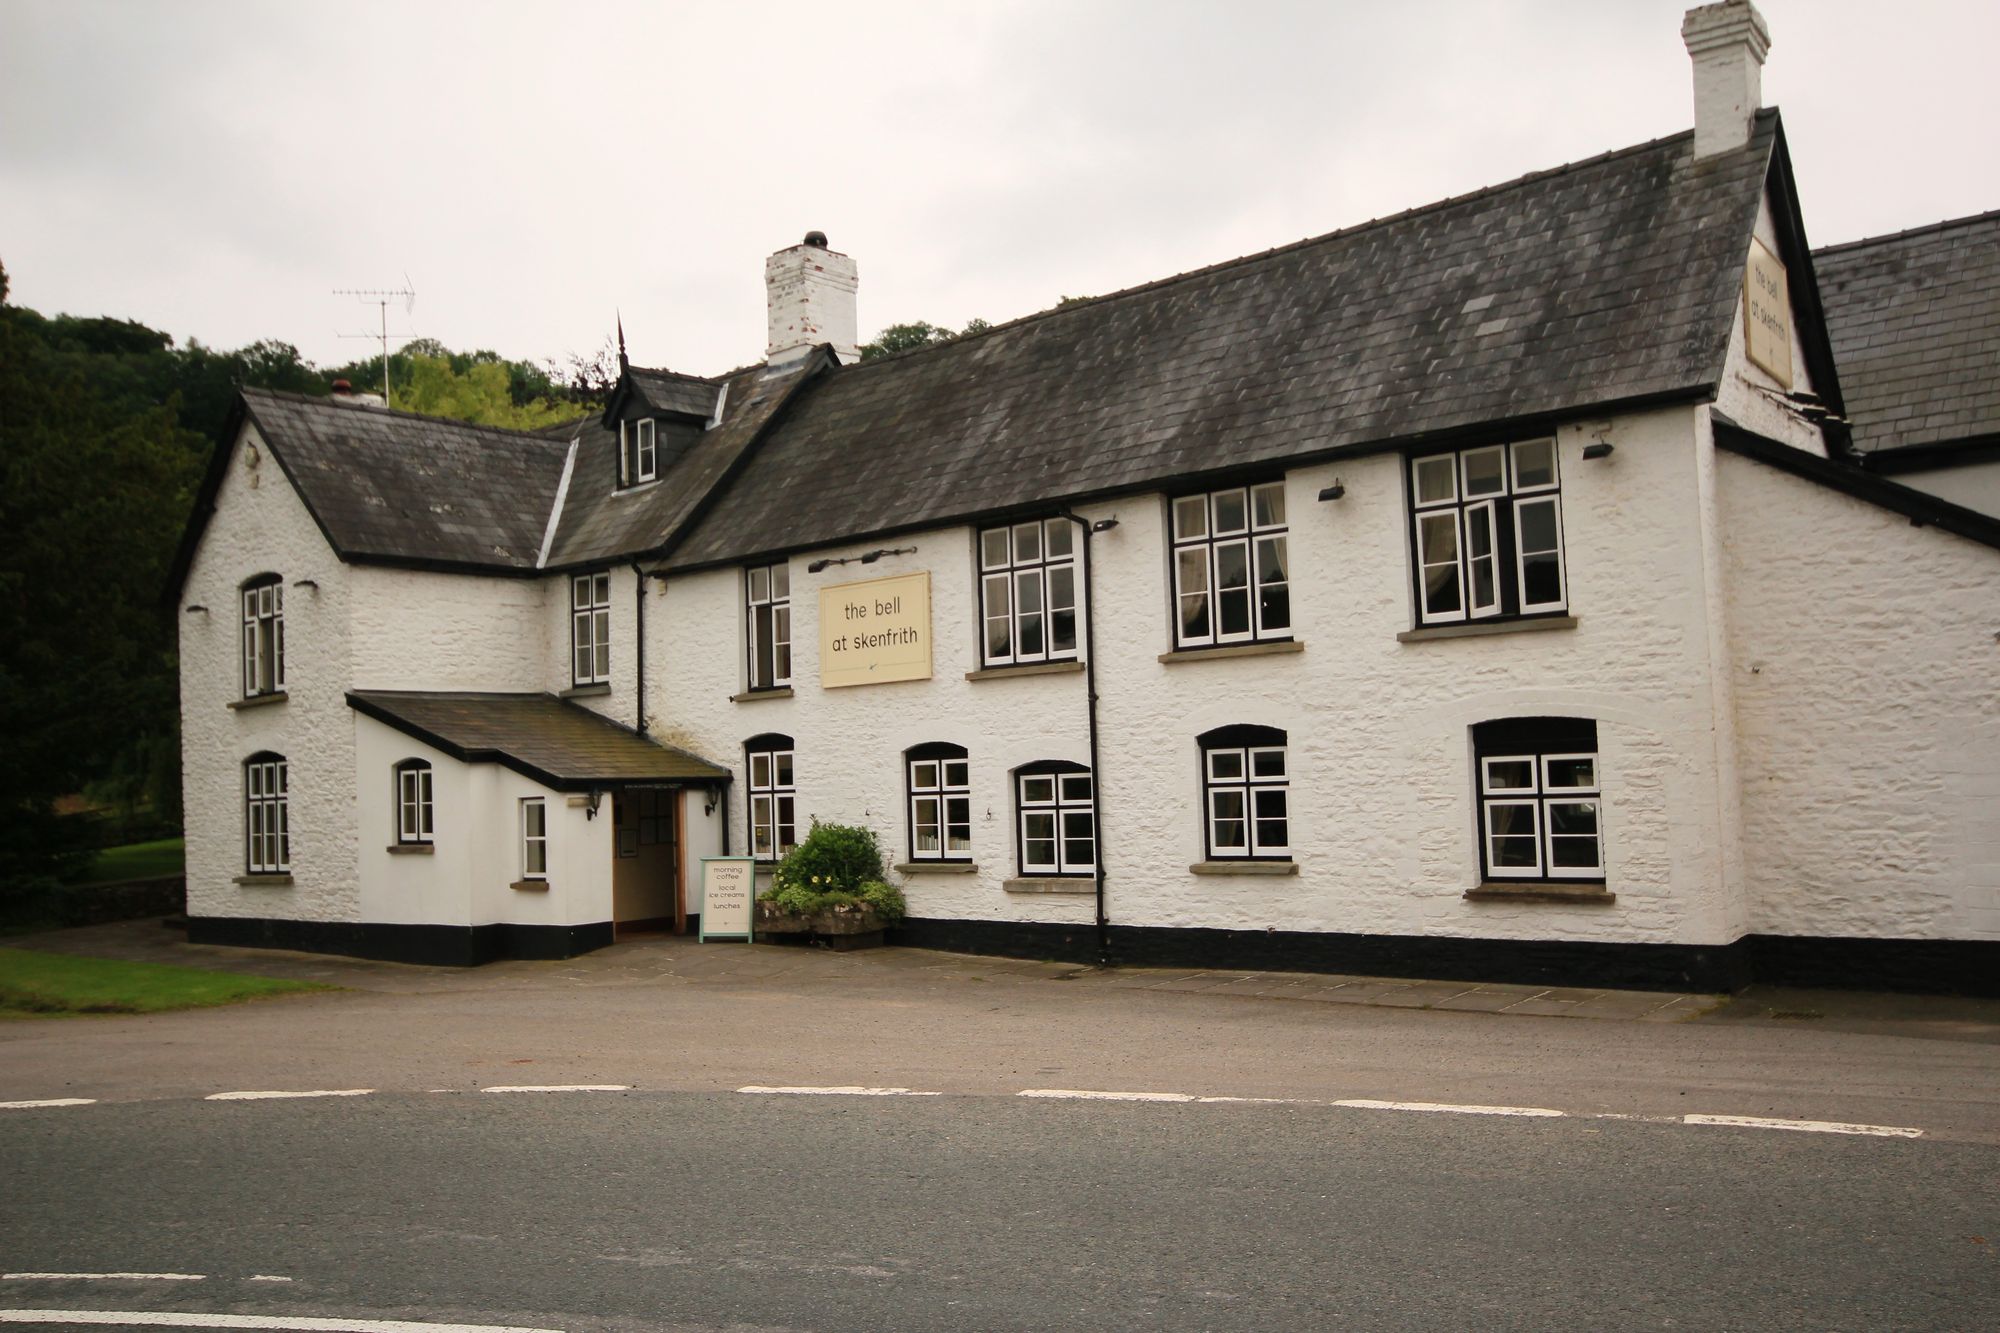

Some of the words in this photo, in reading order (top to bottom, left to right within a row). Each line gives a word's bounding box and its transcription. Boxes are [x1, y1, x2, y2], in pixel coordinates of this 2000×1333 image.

[844, 602, 867, 620] the
[875, 596, 900, 616] bell
[832, 635, 847, 652] at
[853, 626, 918, 649] skenfrith
